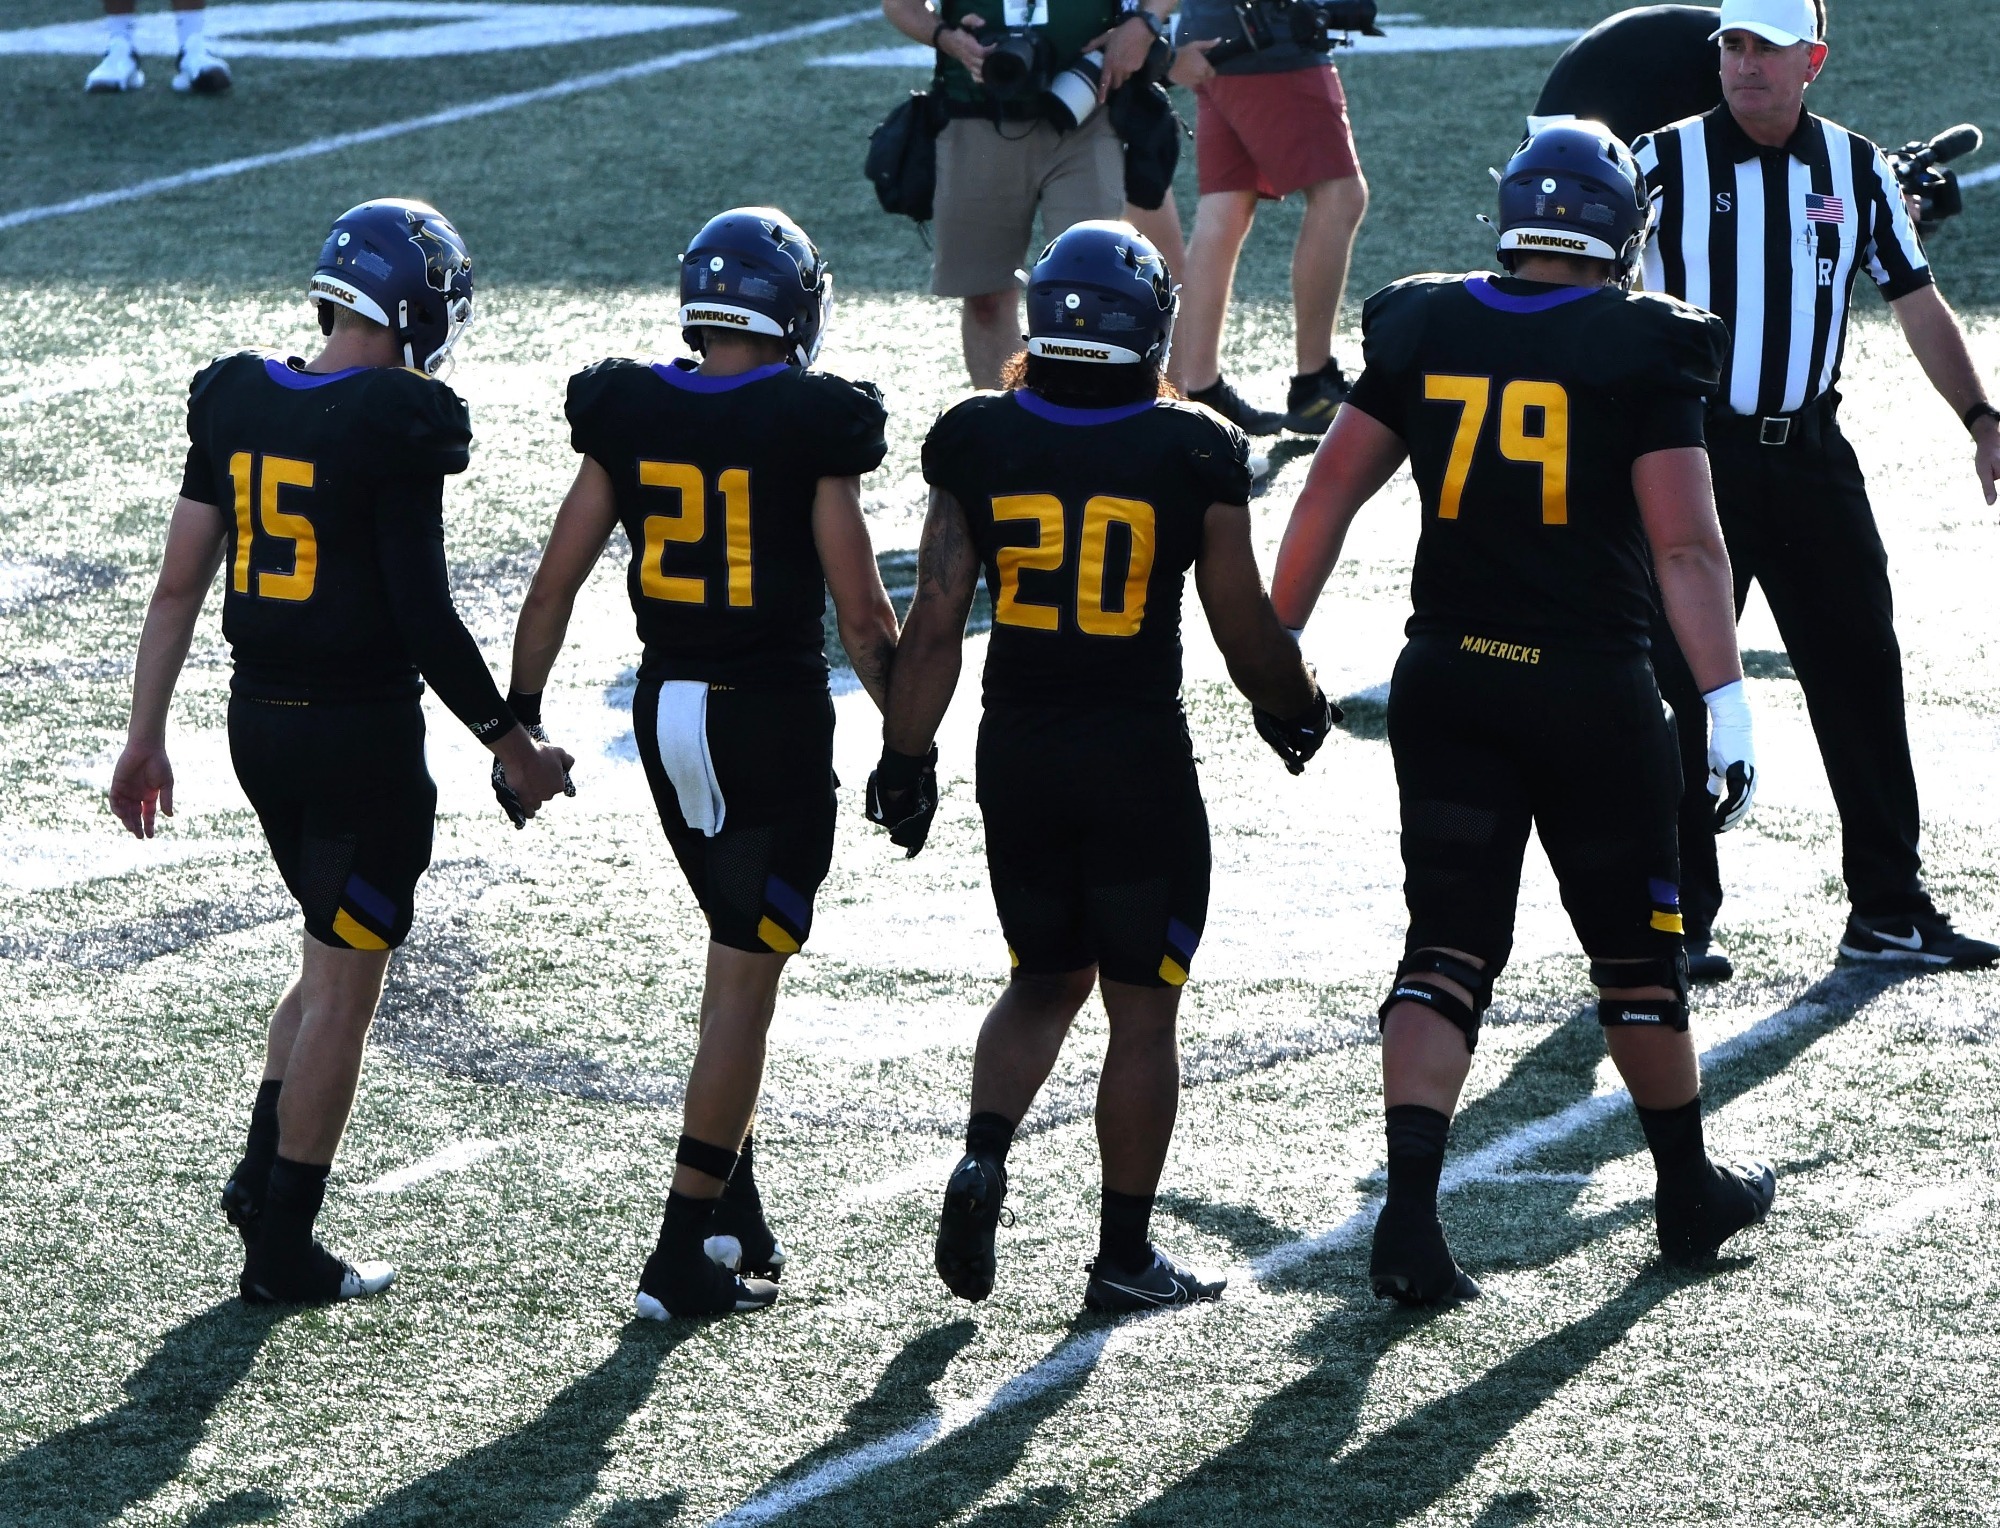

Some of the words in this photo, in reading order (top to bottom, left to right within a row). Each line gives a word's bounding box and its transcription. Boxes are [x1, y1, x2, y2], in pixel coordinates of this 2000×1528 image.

[1716, 193, 1731, 212] S
[1516, 233, 1588, 251] MAVERICKS
[1818, 258, 1833, 285] R
[686, 309, 750, 326] MAVERICKS
[1075, 318, 1084, 327] 20
[1040, 342, 1111, 360] MAVERICKS
[1423, 373, 1569, 526] 79
[228, 451, 318, 602] 15
[637, 459, 754, 608] 21
[990, 493, 1156, 637] 20
[1460, 634, 1541, 665] MAVERICKS
[1630, 1013, 1661, 1022] BREG
